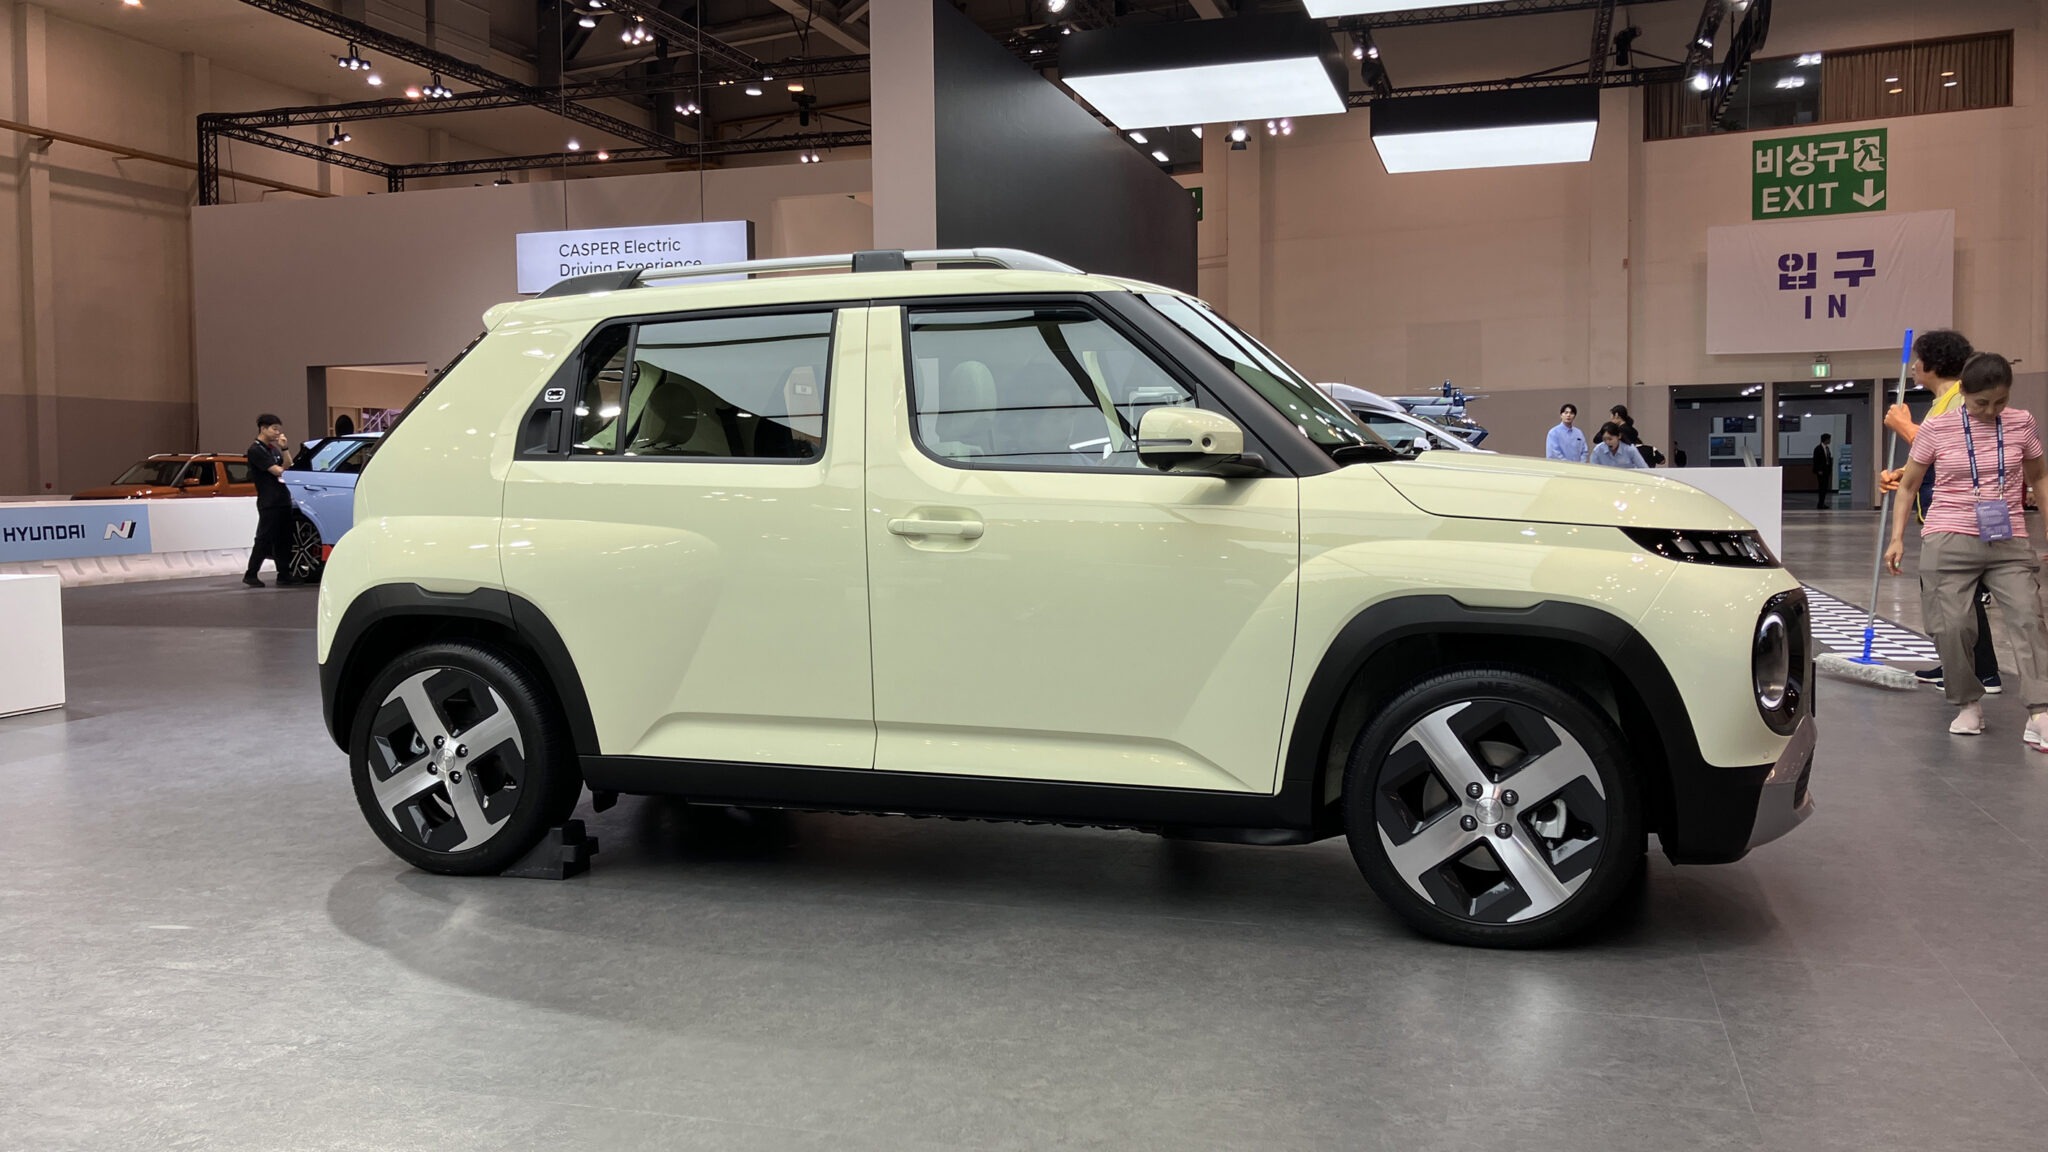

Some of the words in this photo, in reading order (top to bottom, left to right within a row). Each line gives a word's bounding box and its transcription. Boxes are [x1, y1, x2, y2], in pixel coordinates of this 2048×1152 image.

[1756, 140, 1850, 178] 비상구
[1762, 182, 1839, 214] EXIT
[559, 241, 620, 257] CASPER
[624, 237, 681, 254] Electric
[1805, 294, 1847, 319] IN
[3, 524, 86, 543] HYUNDAI
